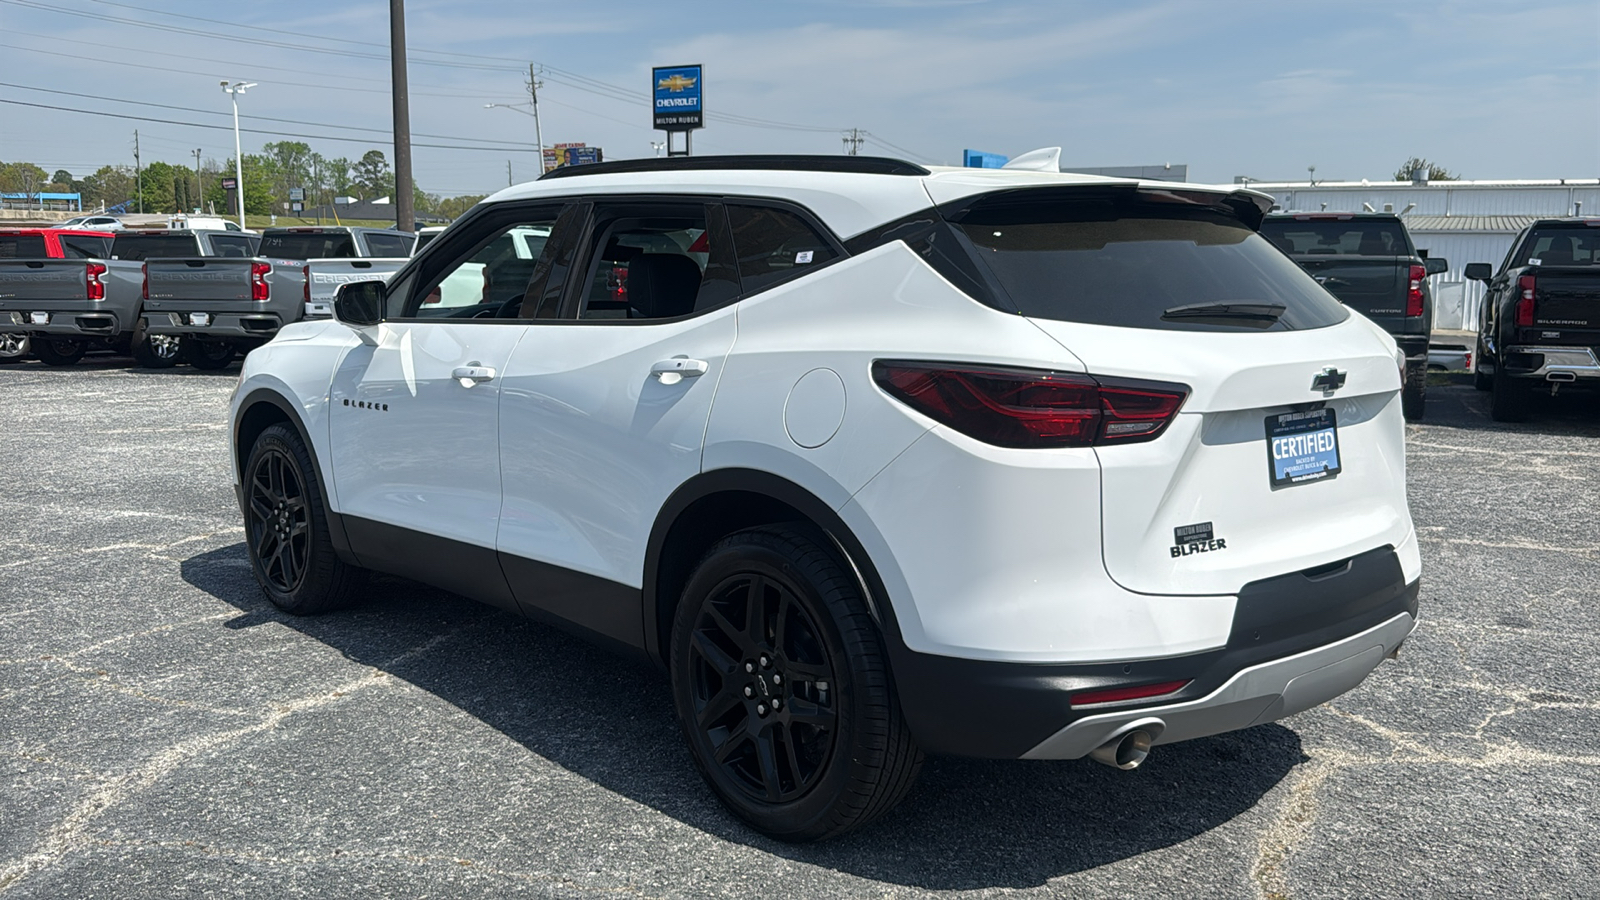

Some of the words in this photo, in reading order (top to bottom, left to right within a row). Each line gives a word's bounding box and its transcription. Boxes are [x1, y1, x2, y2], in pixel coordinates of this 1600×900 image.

[656, 97, 698, 107] CHEVROLET
[0, 272, 78, 282] HEVROLET
[150, 272, 241, 281] CHEVROLET
[343, 398, 389, 412] BLAZER
[1272, 431, 1335, 460] CERTIFIED
[1283, 464, 1305, 473] CHEVROLET
[1305, 462, 1316, 470] BUICK
[1176, 526, 1196, 537] MILTON
[1195, 523, 1212, 533] RUBEN
[1170, 538, 1227, 558] BLAZER
